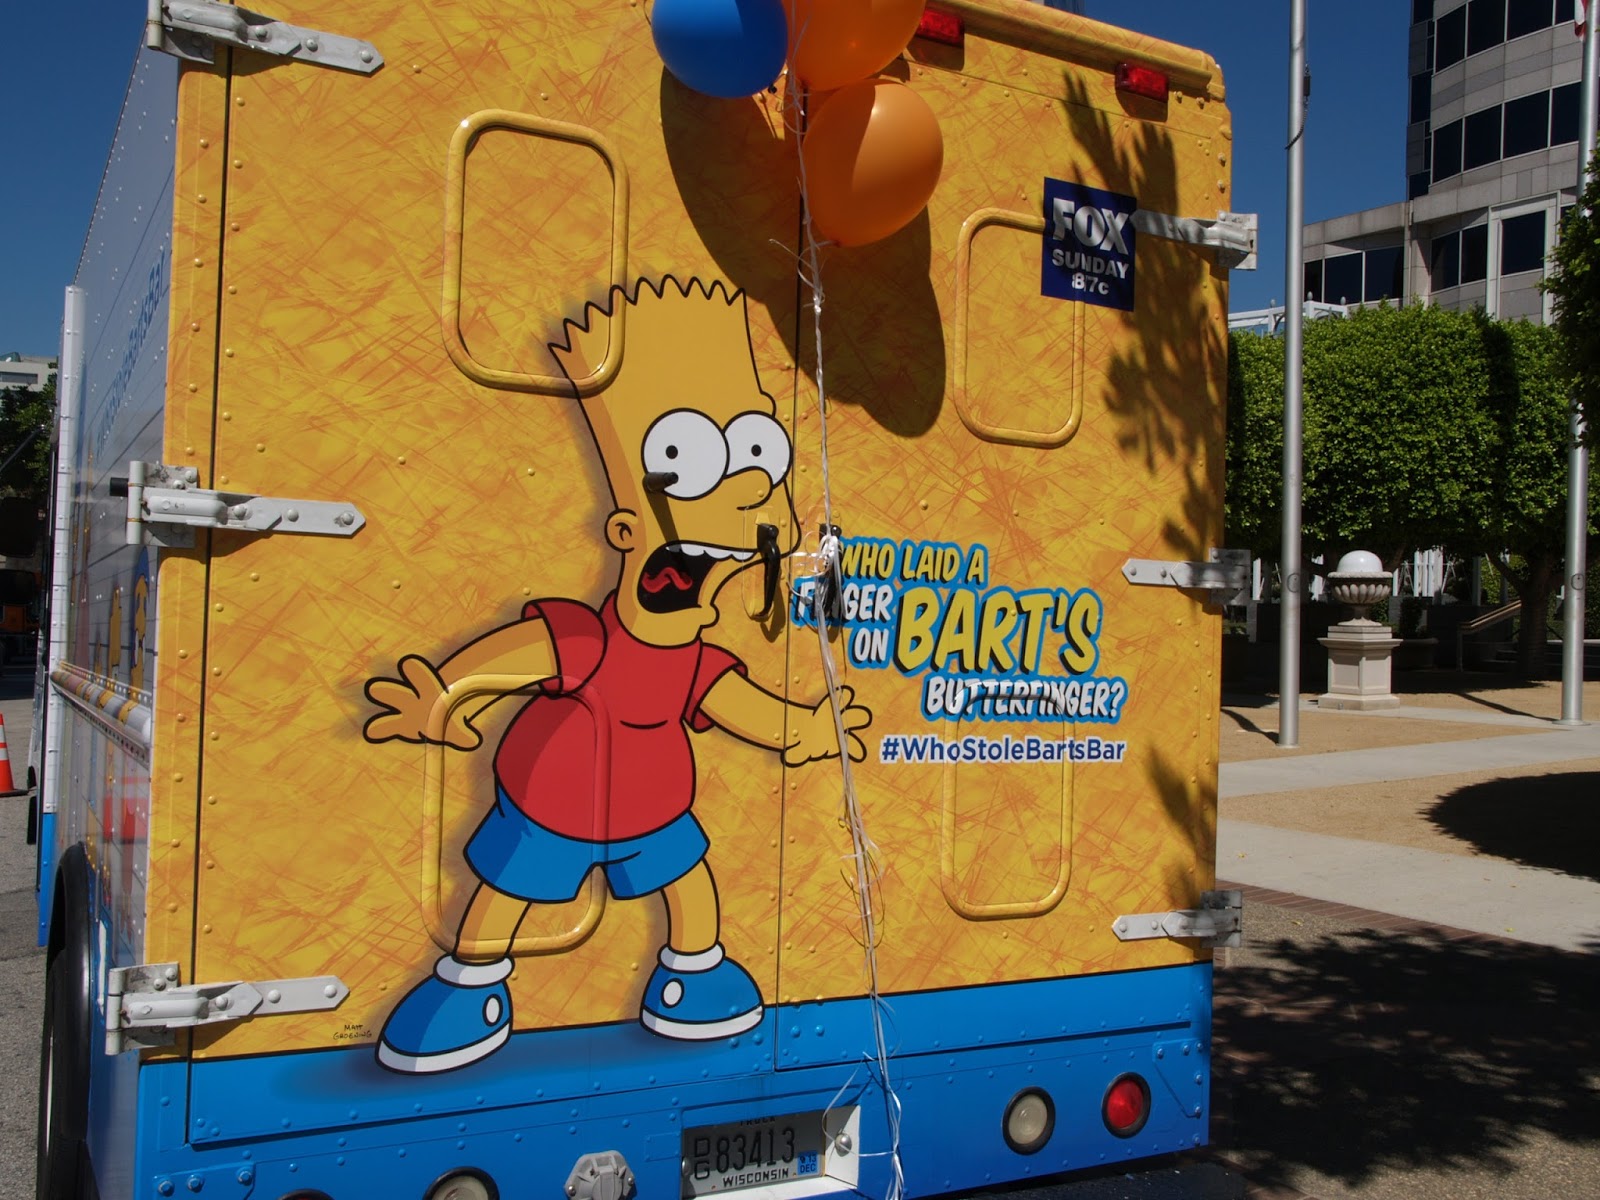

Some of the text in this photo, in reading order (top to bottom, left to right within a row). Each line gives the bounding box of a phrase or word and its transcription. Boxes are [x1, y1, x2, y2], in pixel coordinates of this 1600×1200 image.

[1052, 197, 1129, 255] FOX
[1052, 248, 1129, 279] SUNDAY
[840, 541, 984, 584] WHO LAID A
[796, 582, 894, 622] FGER
[853, 587, 1100, 675] ON BART'S
[924, 675, 1125, 719] BUTTERFINGER?
[881, 736, 1126, 760] #WhoStoleBartsBar
[722, 1168, 789, 1187] WISCONSIN
[800, 1163, 817, 1173] DEC
